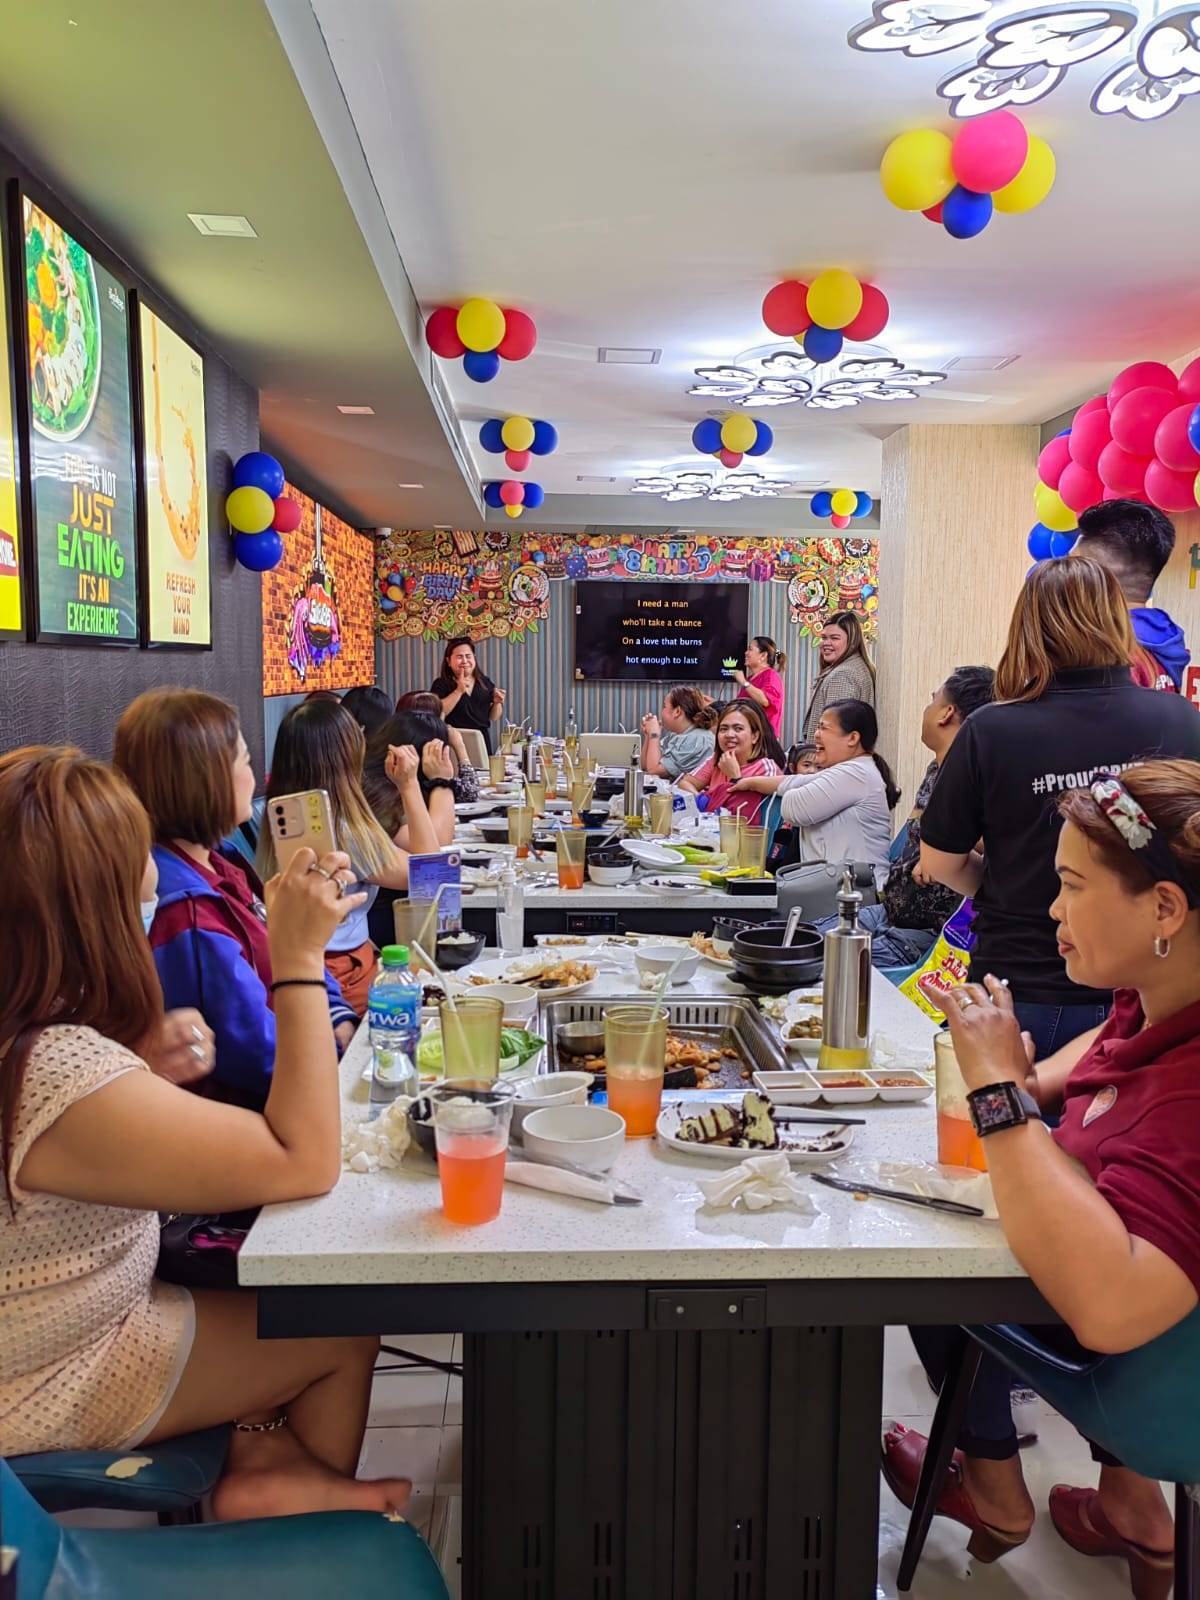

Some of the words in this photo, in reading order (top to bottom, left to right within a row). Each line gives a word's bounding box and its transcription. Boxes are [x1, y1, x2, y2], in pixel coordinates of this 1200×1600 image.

[101, 470, 117, 499] NOT
[69, 484, 114, 536] JUST
[57, 522, 125, 579] EATING
[644, 541, 695, 559] HAPPY
[423, 562, 467, 577] HAPPY
[79, 573, 97, 603] IT'S
[97, 577, 110, 604] AN
[166, 571, 196, 596] REFRESH
[428, 586, 457, 601] DAY
[173, 594, 191, 615] YOUR
[642, 599, 662, 608] need
[67, 601, 119, 635] EXPERIENCE
[622, 618, 646, 626] who'll
[648, 618, 665, 627] take
[674, 619, 702, 627] chance
[622, 637, 634, 645] On
[643, 637, 659, 645] love
[661, 637, 677, 646] that
[679, 637, 703, 646] burns
[625, 655, 639, 664] hot
[641, 655, 671, 666] enough
[683, 656, 698, 665] last
